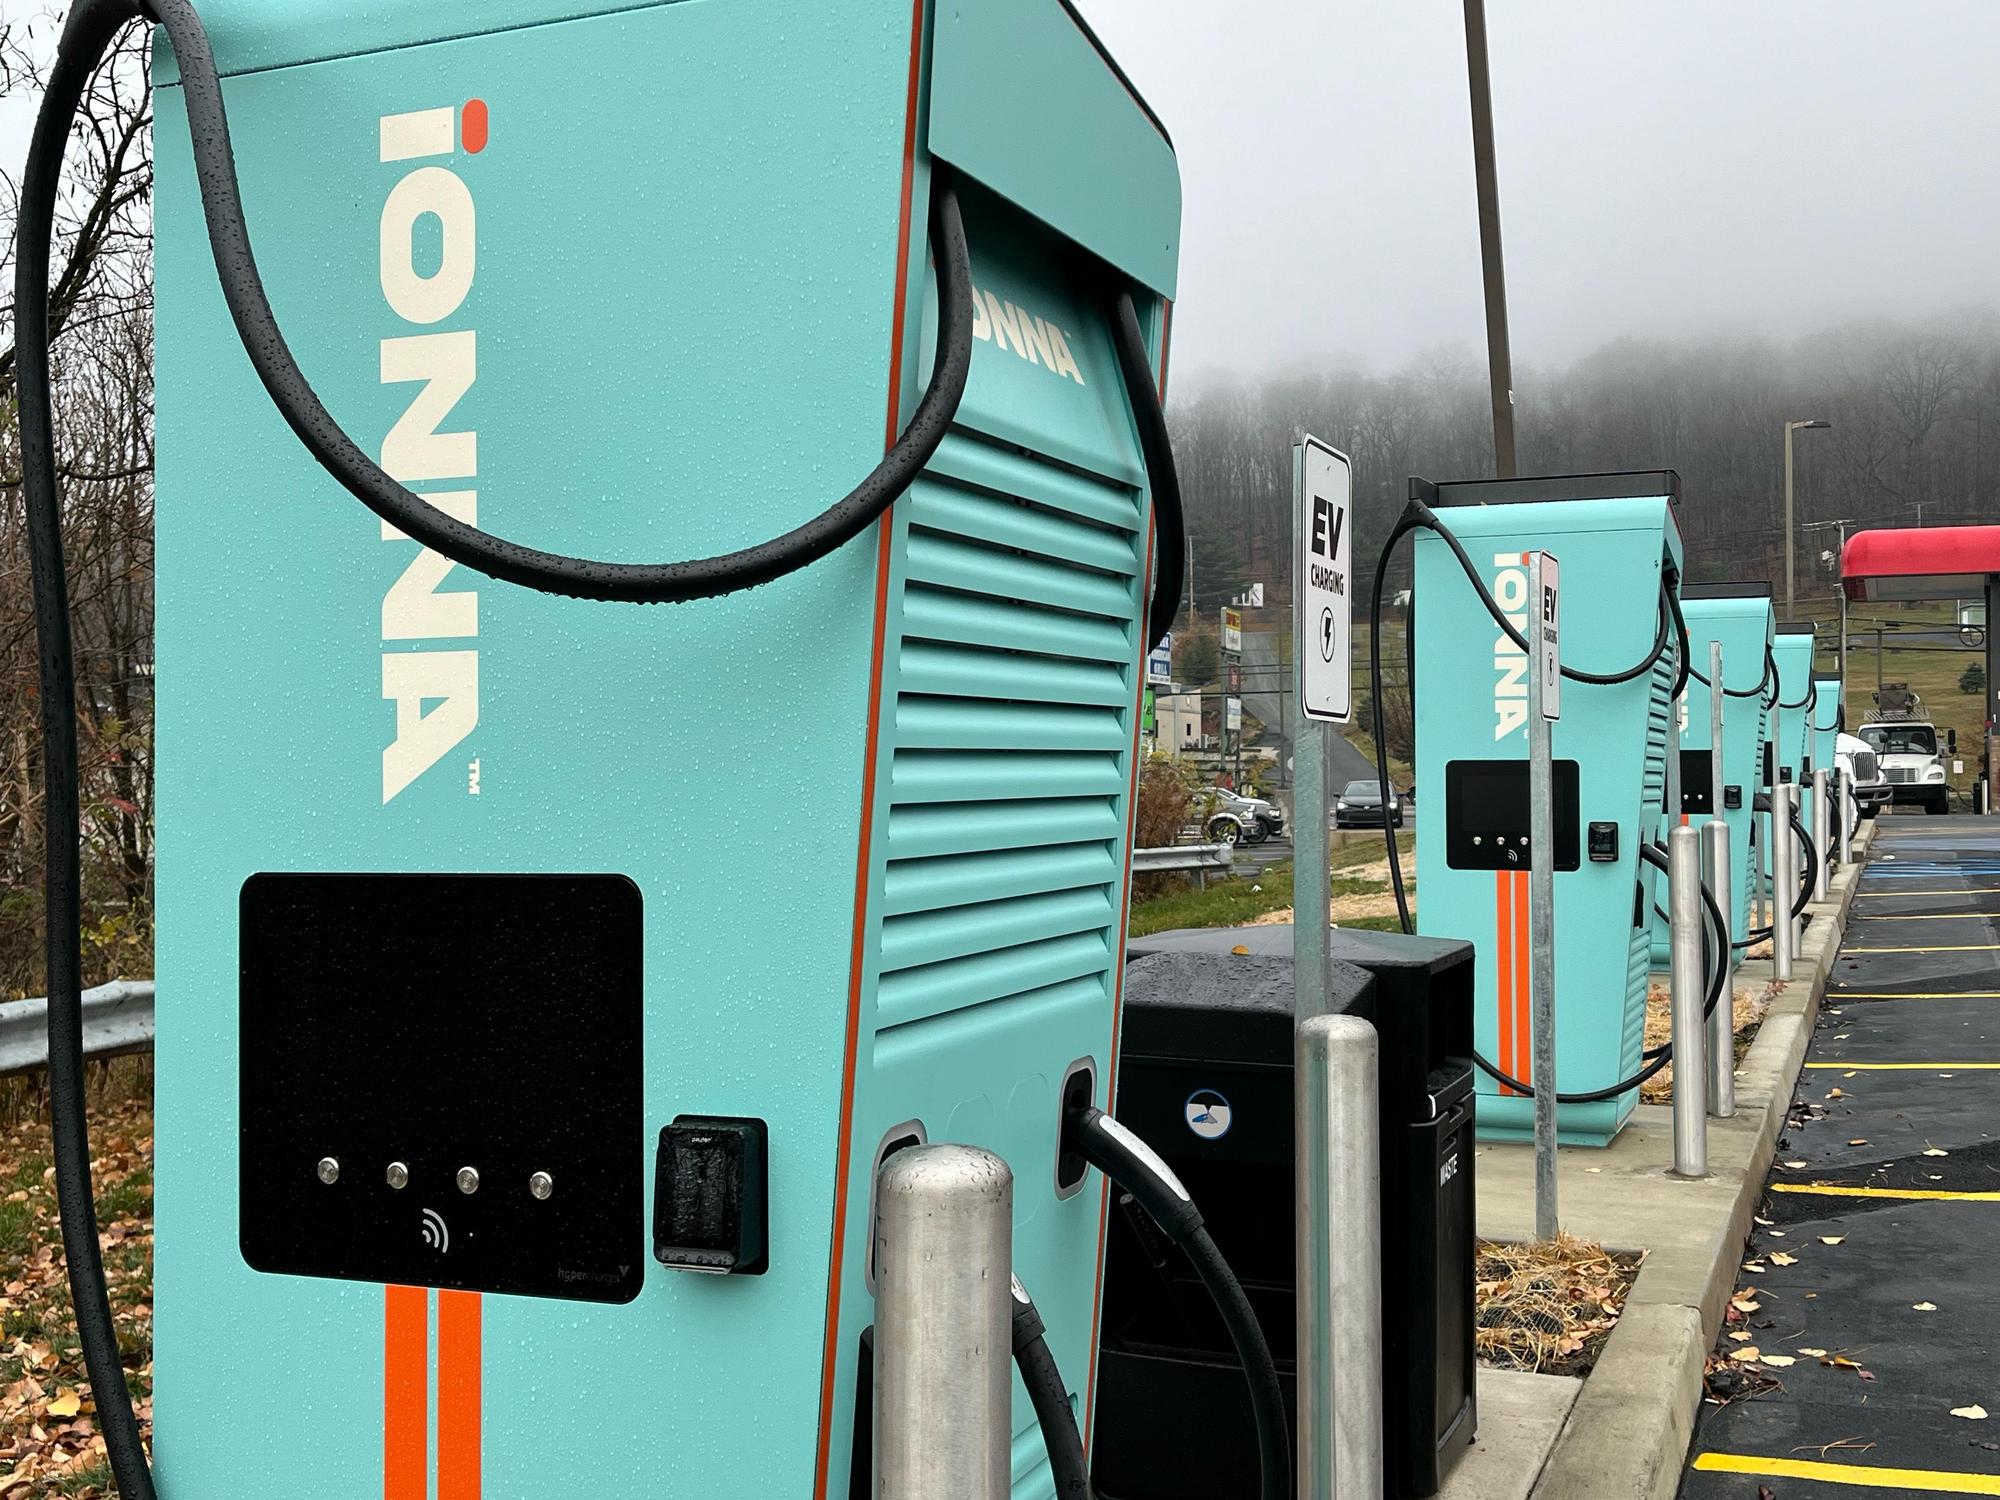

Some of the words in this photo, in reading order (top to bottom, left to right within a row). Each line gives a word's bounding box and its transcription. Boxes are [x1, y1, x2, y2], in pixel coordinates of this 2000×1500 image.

[1311, 494, 1344, 561] EV
[1311, 563, 1344, 596] CHARGING
[1544, 585, 1557, 624] EV
[1440, 1153, 1457, 1187] WASTE
